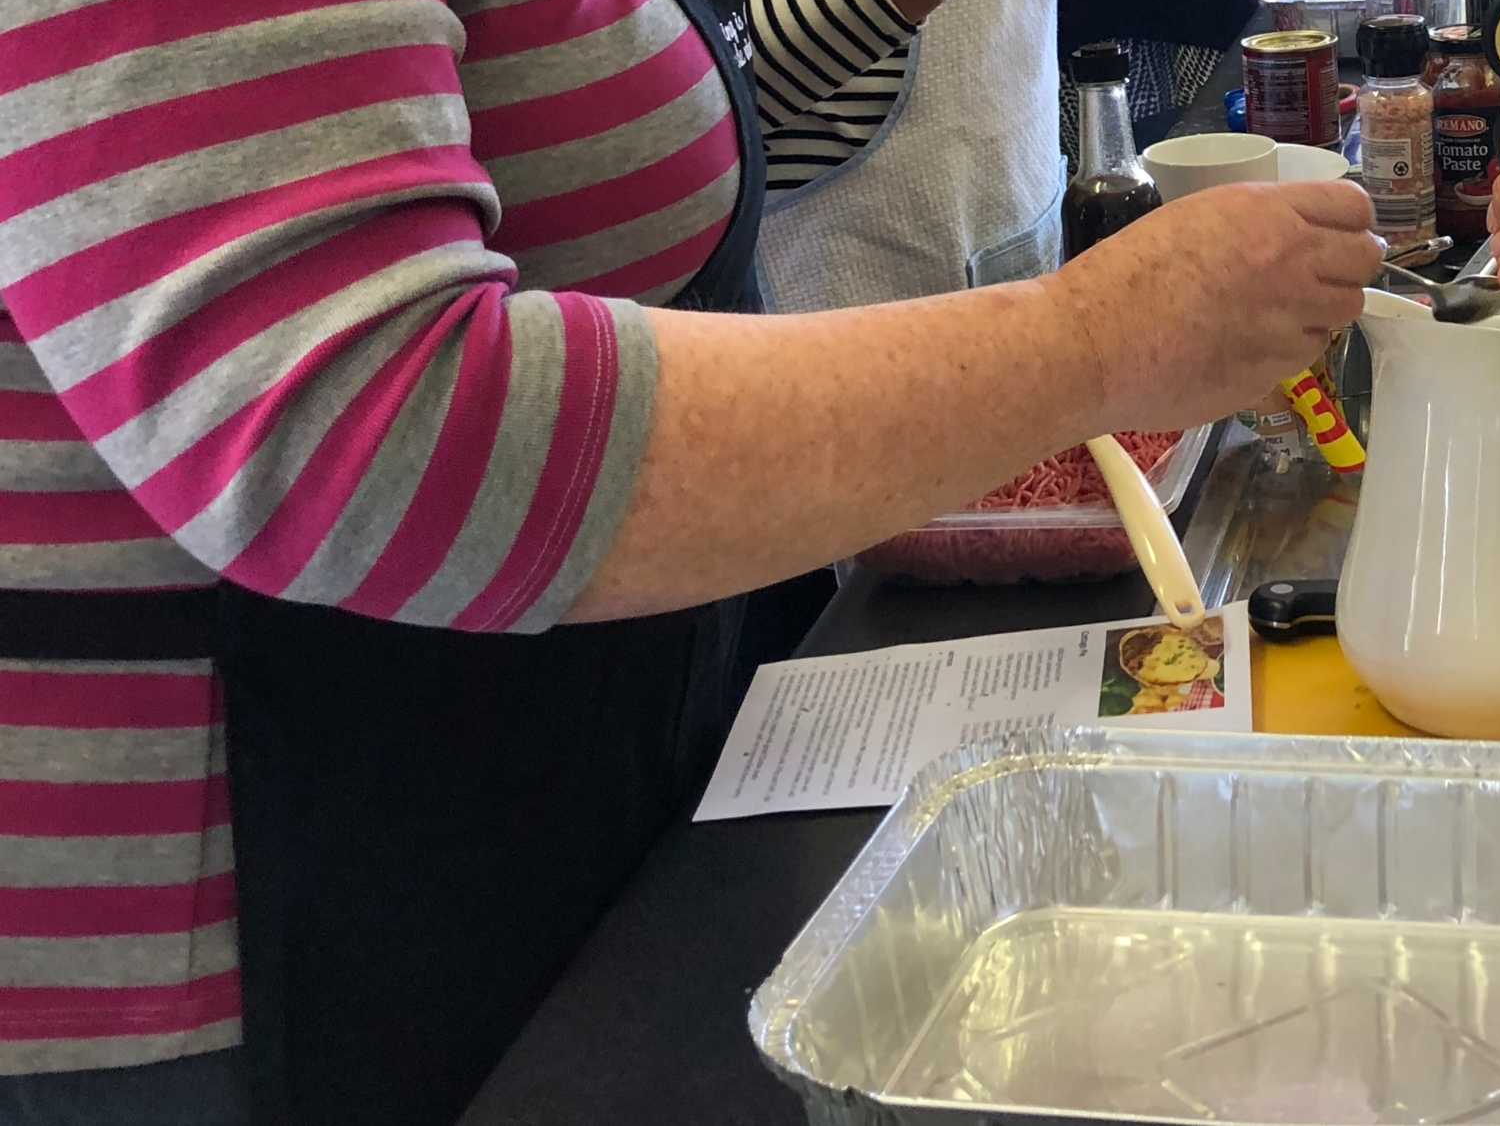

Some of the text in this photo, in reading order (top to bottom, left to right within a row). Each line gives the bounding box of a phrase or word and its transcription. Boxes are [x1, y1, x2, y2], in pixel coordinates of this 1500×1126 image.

[1435, 120, 1484, 131] REMANO
[1435, 141, 1489, 157] Tomato
[1443, 156, 1482, 171] Paste
